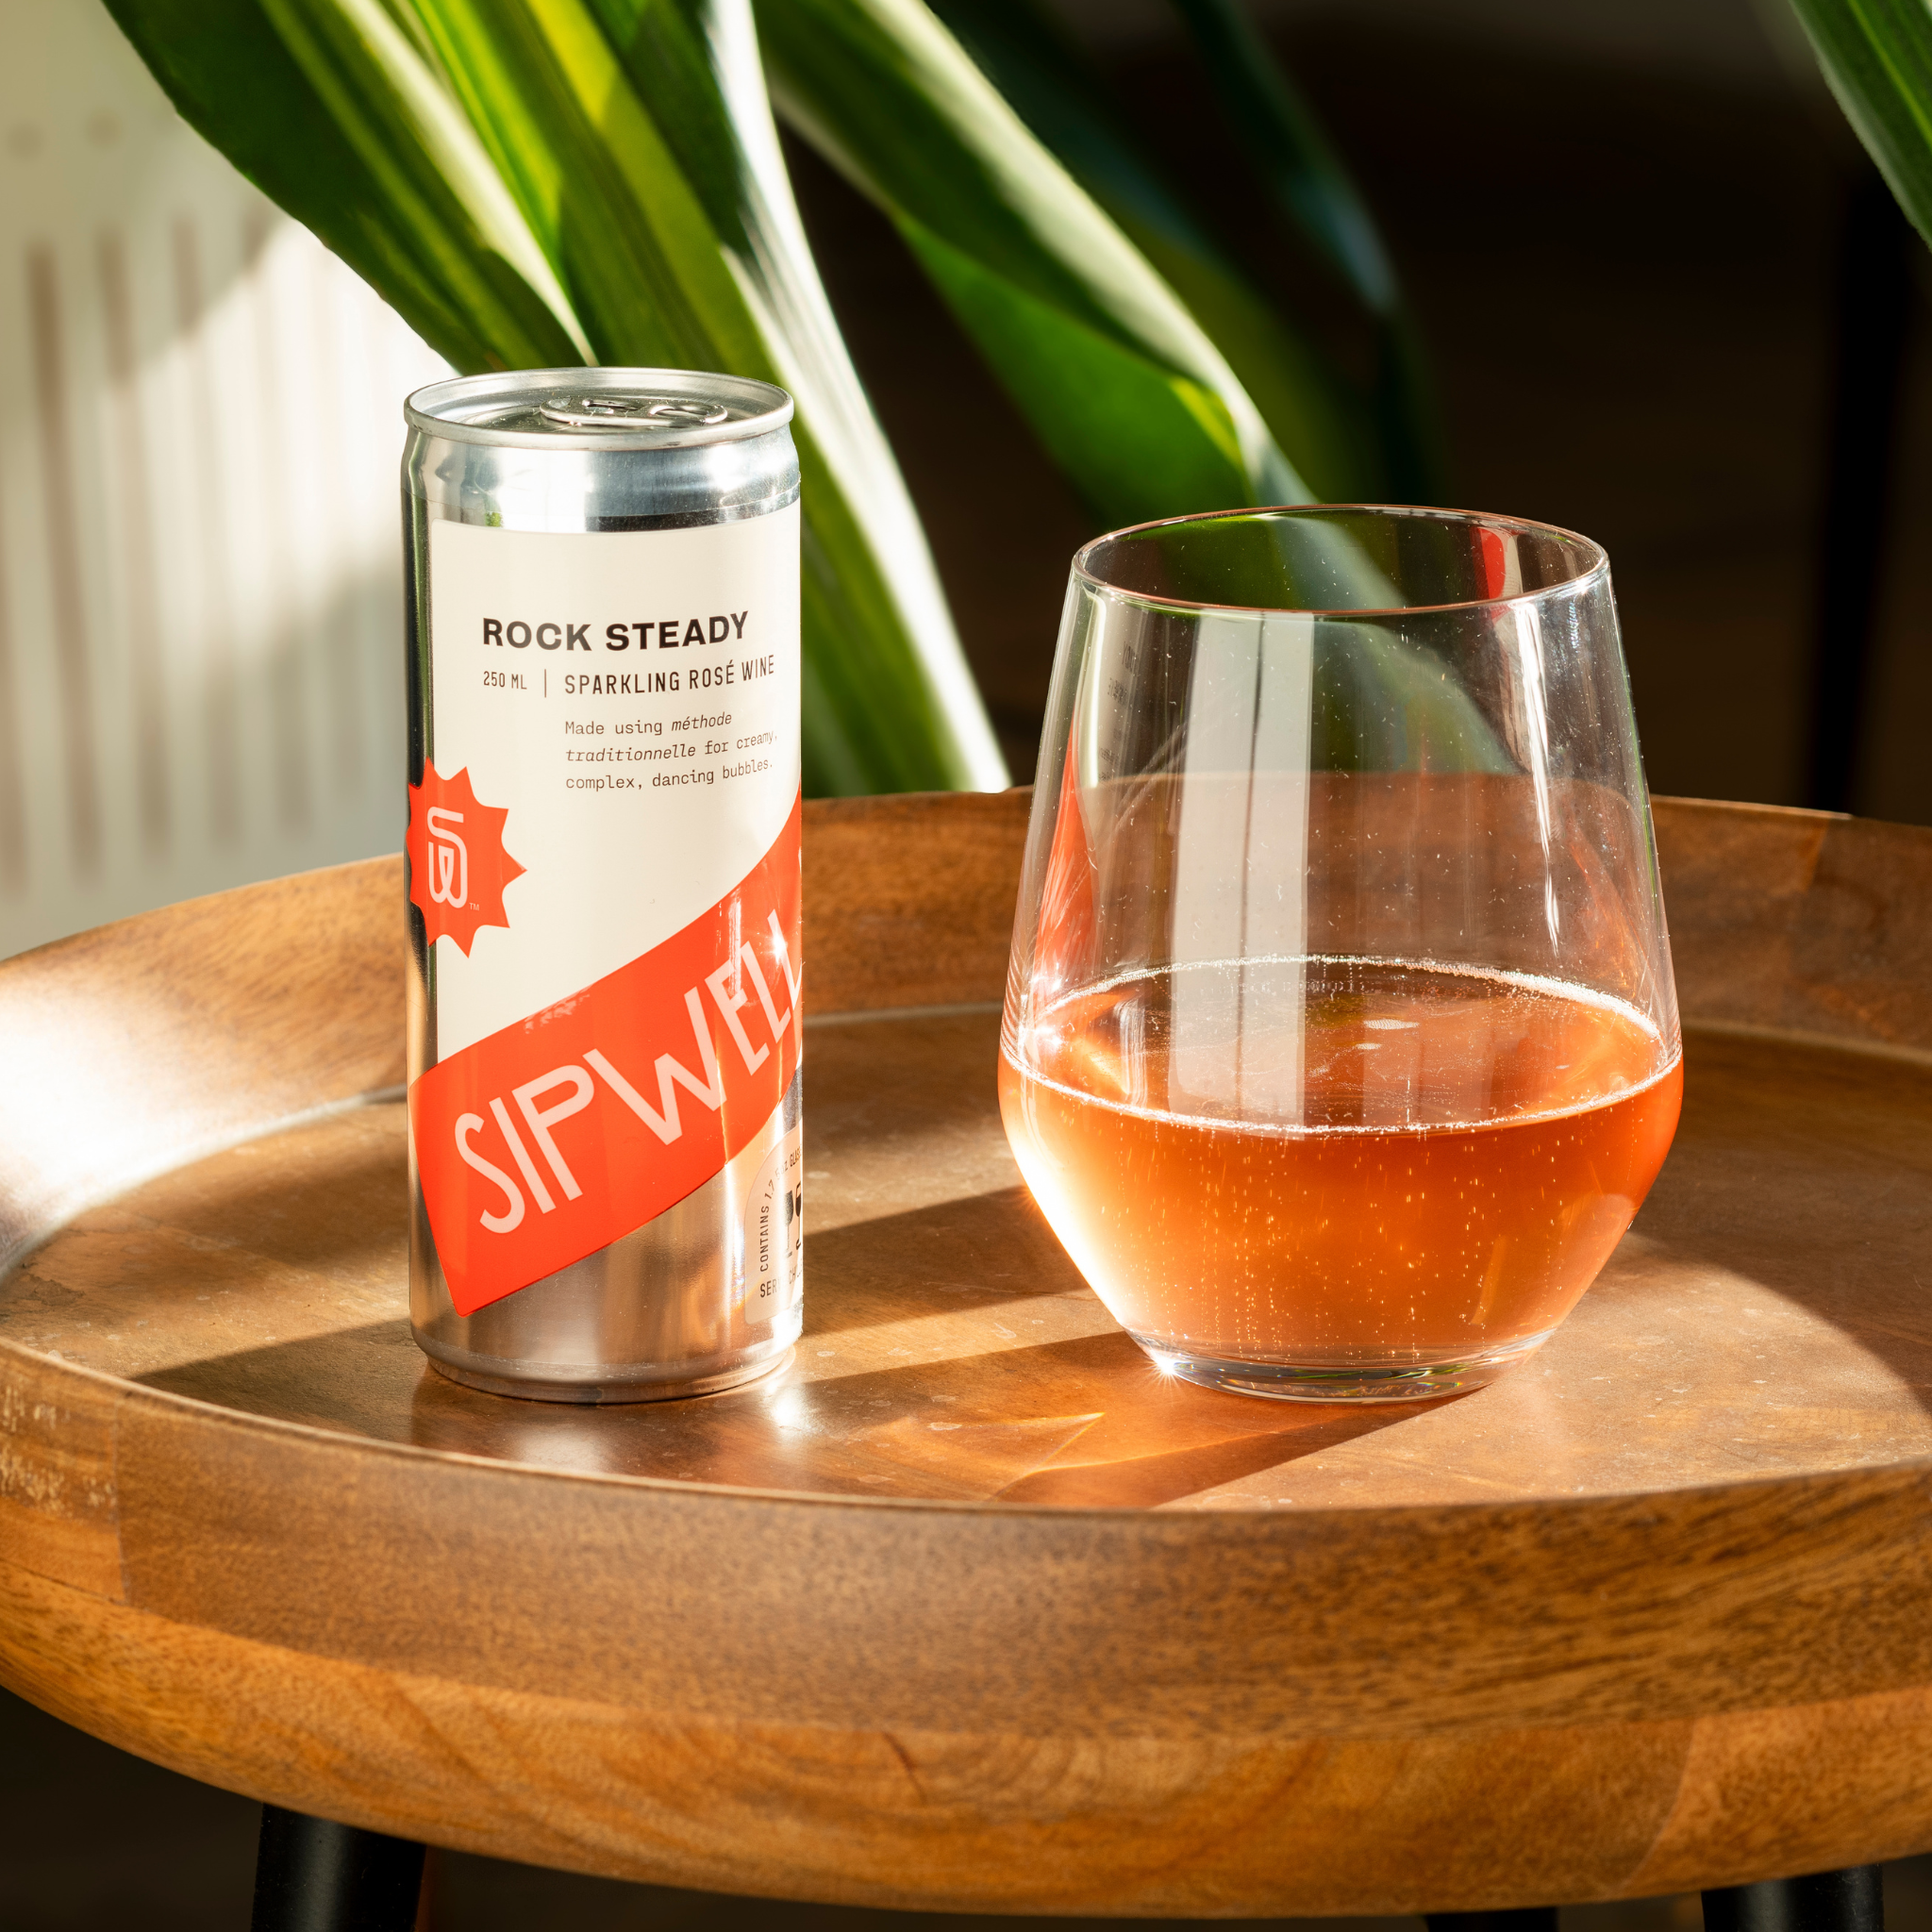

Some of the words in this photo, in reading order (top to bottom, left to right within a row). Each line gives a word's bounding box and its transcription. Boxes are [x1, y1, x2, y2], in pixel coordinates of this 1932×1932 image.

[482, 617, 592, 652] ROCK
[605, 609, 749, 652] STEADY
[483, 670, 506, 688] 250
[510, 673, 527, 691] ML
[564, 671, 680, 695] SPARKLING
[689, 658, 735, 691] ROSÉ
[741, 654, 774, 682] WINE
[565, 720, 605, 735] Made
[614, 719, 663, 736] using
[671, 710, 732, 732] méthode
[566, 743, 696, 762] traditionnelle
[704, 740, 730, 756] for
[736, 729, 778, 751] creamy,
[565, 774, 643, 792] complex,
[652, 769, 714, 788] dancing
[722, 758, 773, 780] bubbles.
[759, 1205, 770, 1273] CONTAINS
